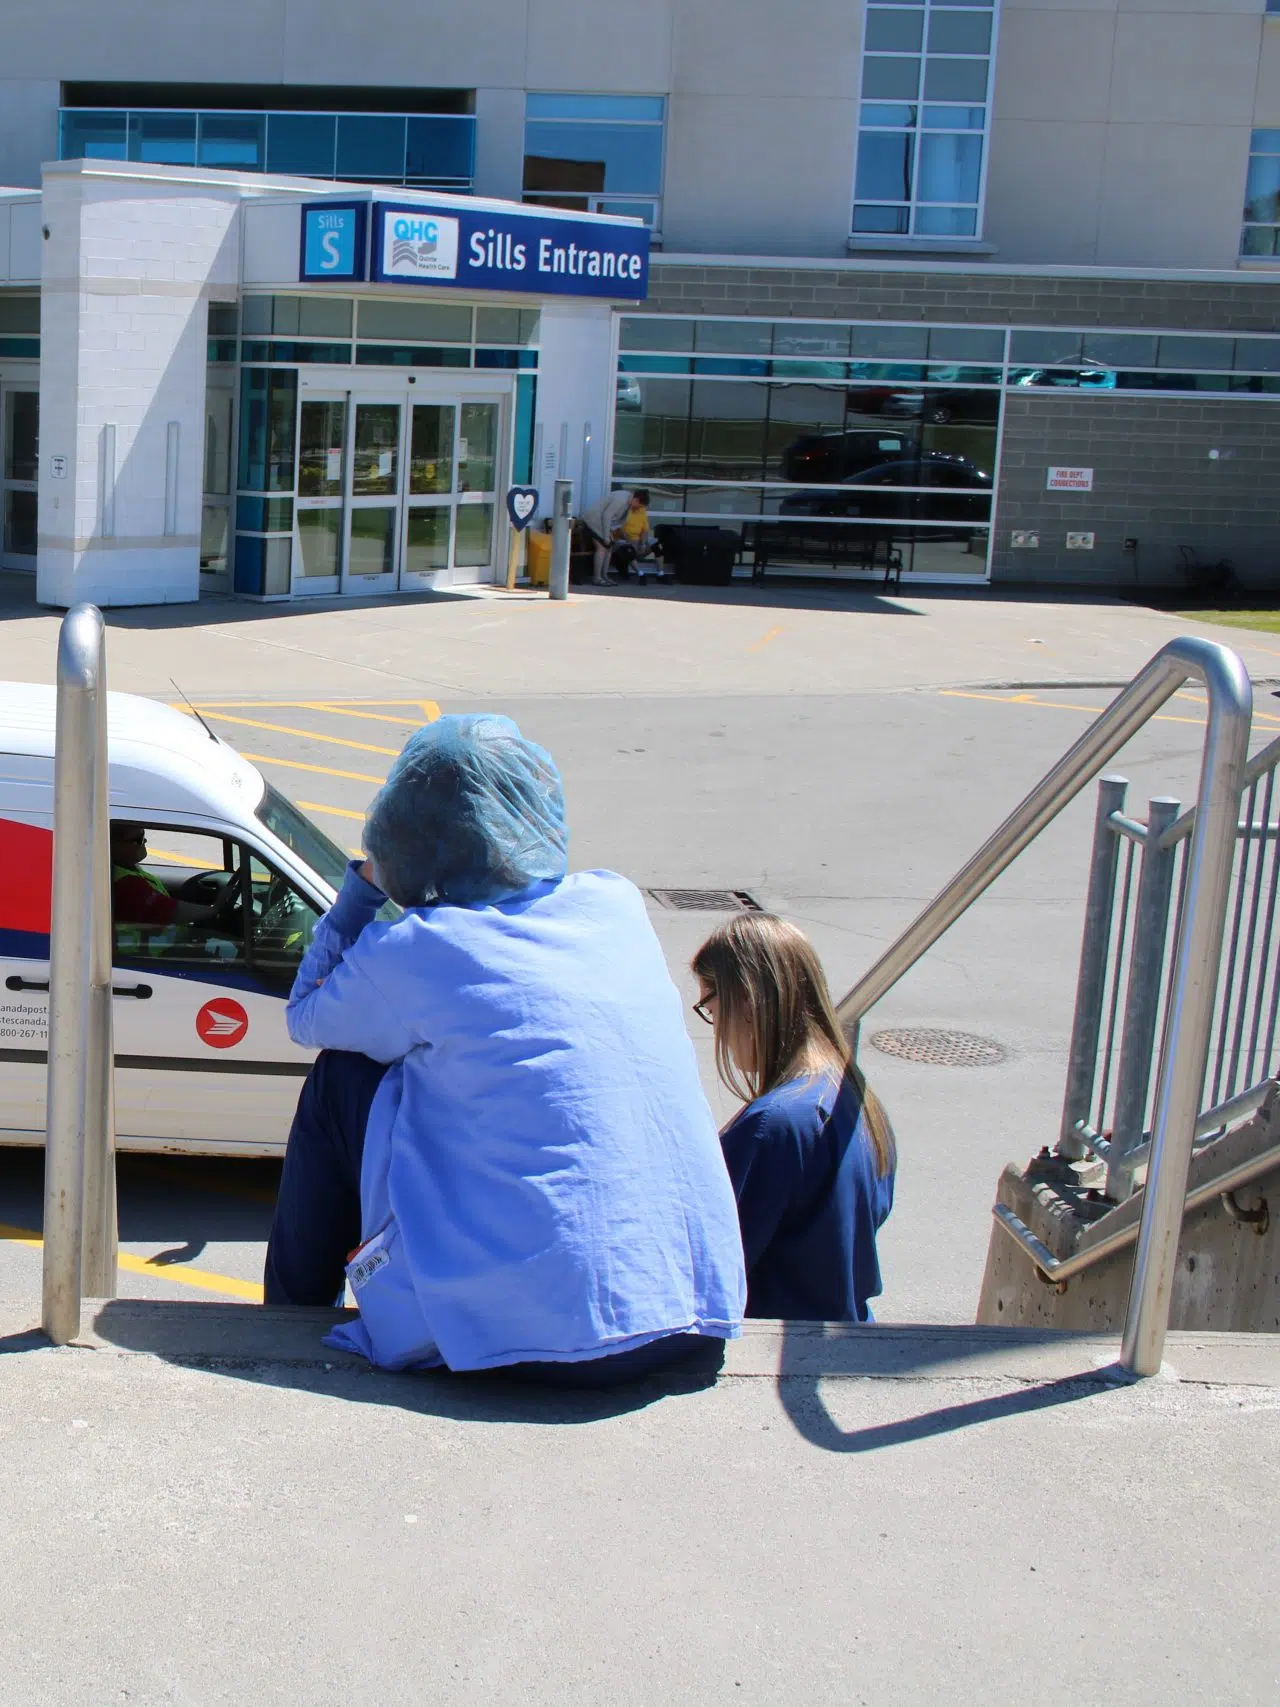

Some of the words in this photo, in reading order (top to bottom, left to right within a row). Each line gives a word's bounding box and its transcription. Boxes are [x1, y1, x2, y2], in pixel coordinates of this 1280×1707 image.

[317, 215, 345, 229] Sills
[394, 218, 438, 241] QHC
[320, 231, 340, 269] S
[468, 229, 526, 271] Sills
[538, 238, 642, 280] Entrance
